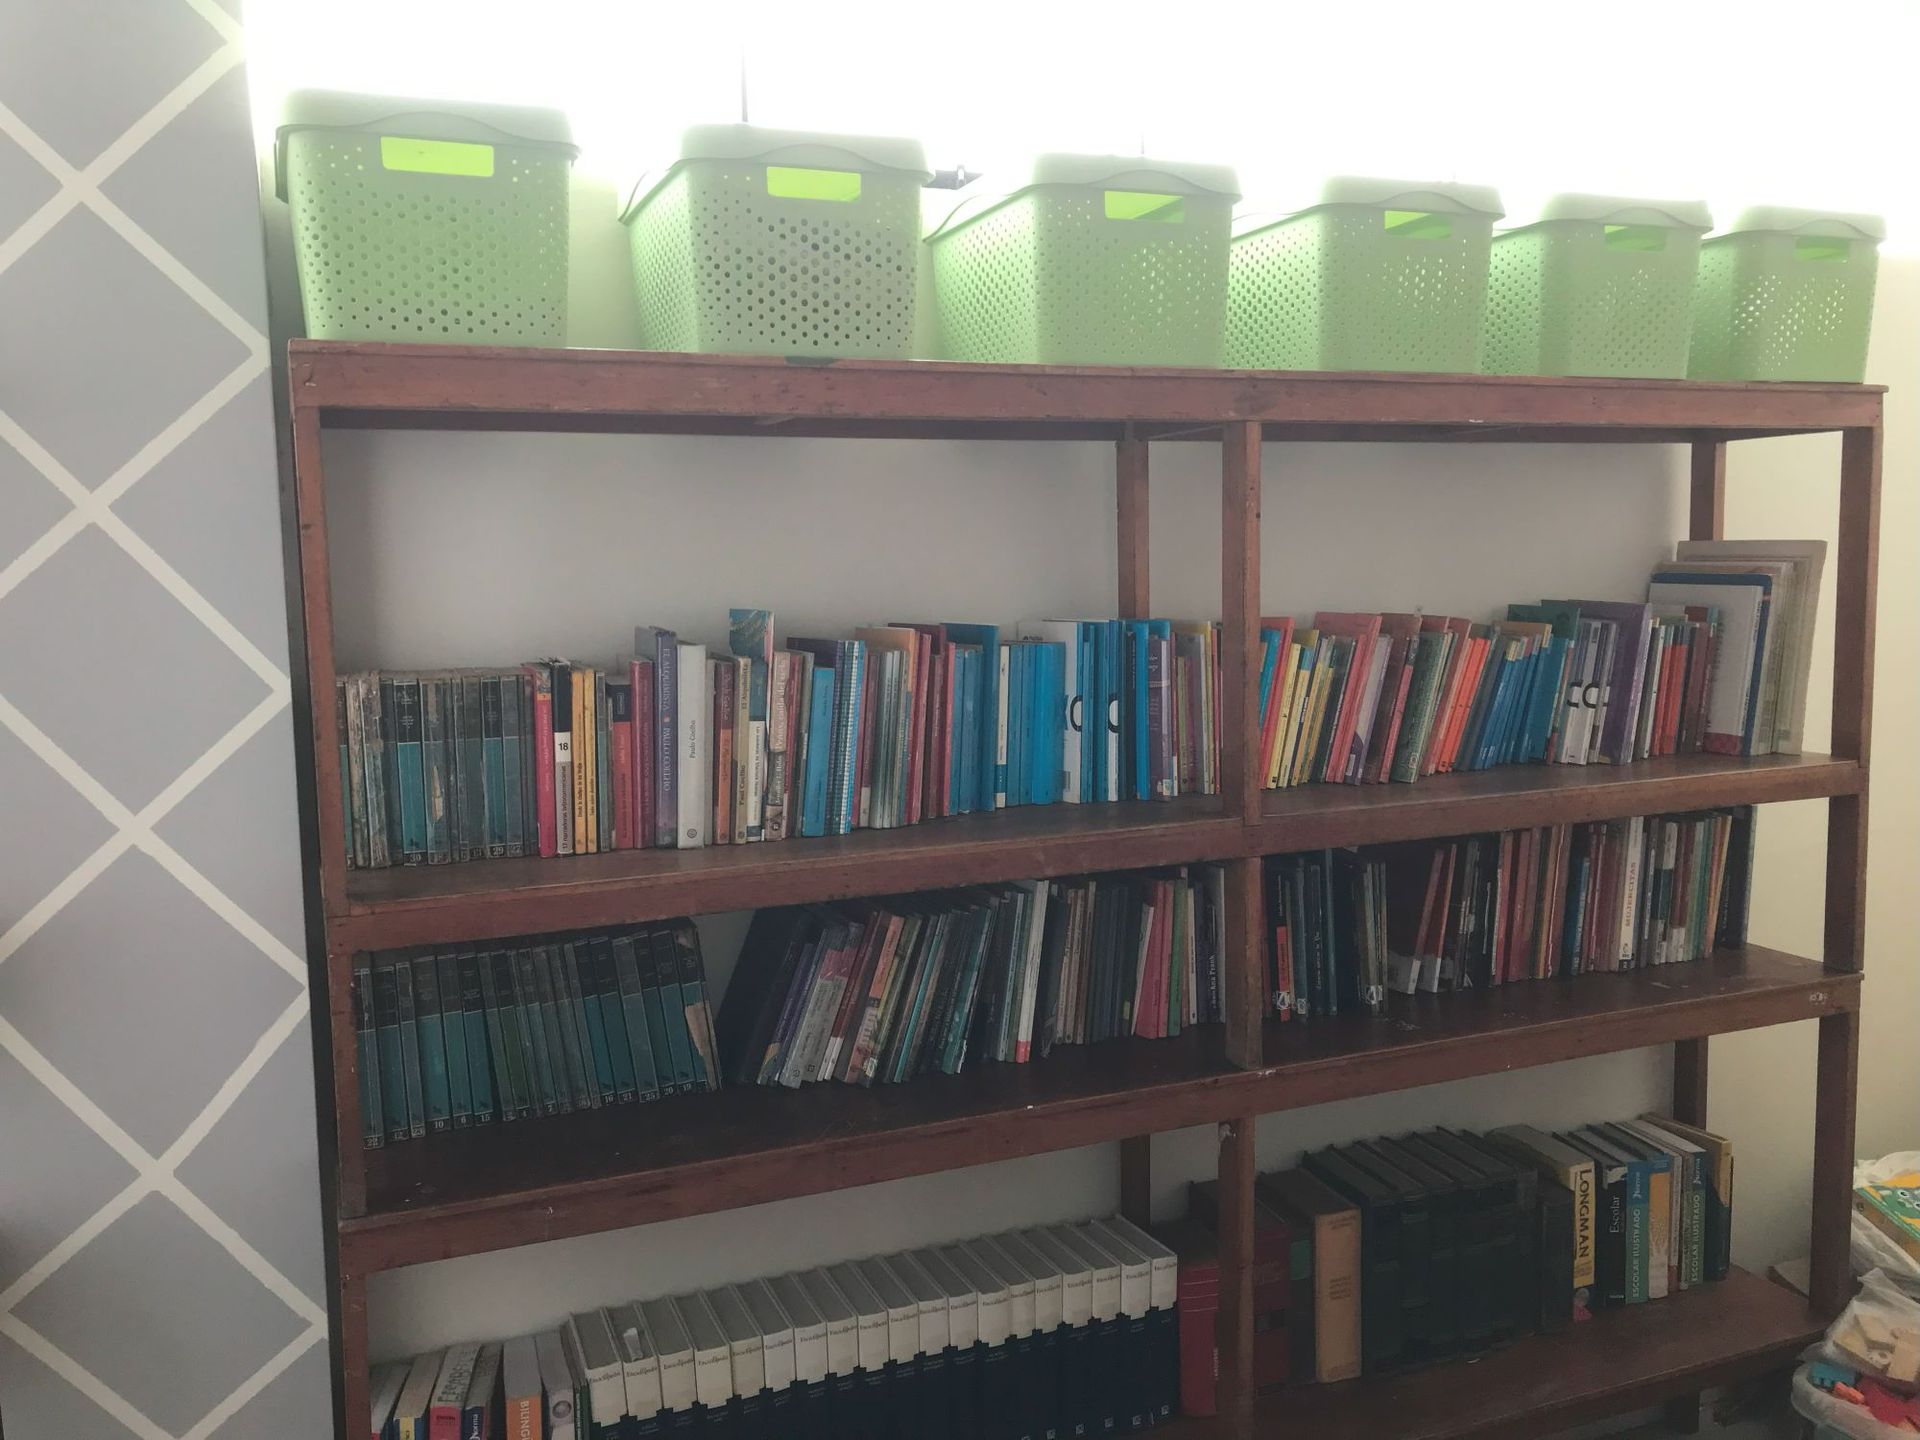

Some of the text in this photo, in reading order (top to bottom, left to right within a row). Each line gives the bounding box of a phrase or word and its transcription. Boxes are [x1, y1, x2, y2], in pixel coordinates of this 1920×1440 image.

[558, 742, 569, 751] 18
[409, 854, 422, 863] 30
[1623, 861, 1638, 928] MUJERCITAS
[434, 1120, 445, 1129] 10
[1578, 1168, 1592, 1258] LONGMAN
[1609, 1196, 1620, 1233] Escolar
[1690, 1194, 1701, 1282] ESCOLAR ILUSTRADO
[1631, 1208, 1641, 1298] ESCOLAR ILUSTRADO
